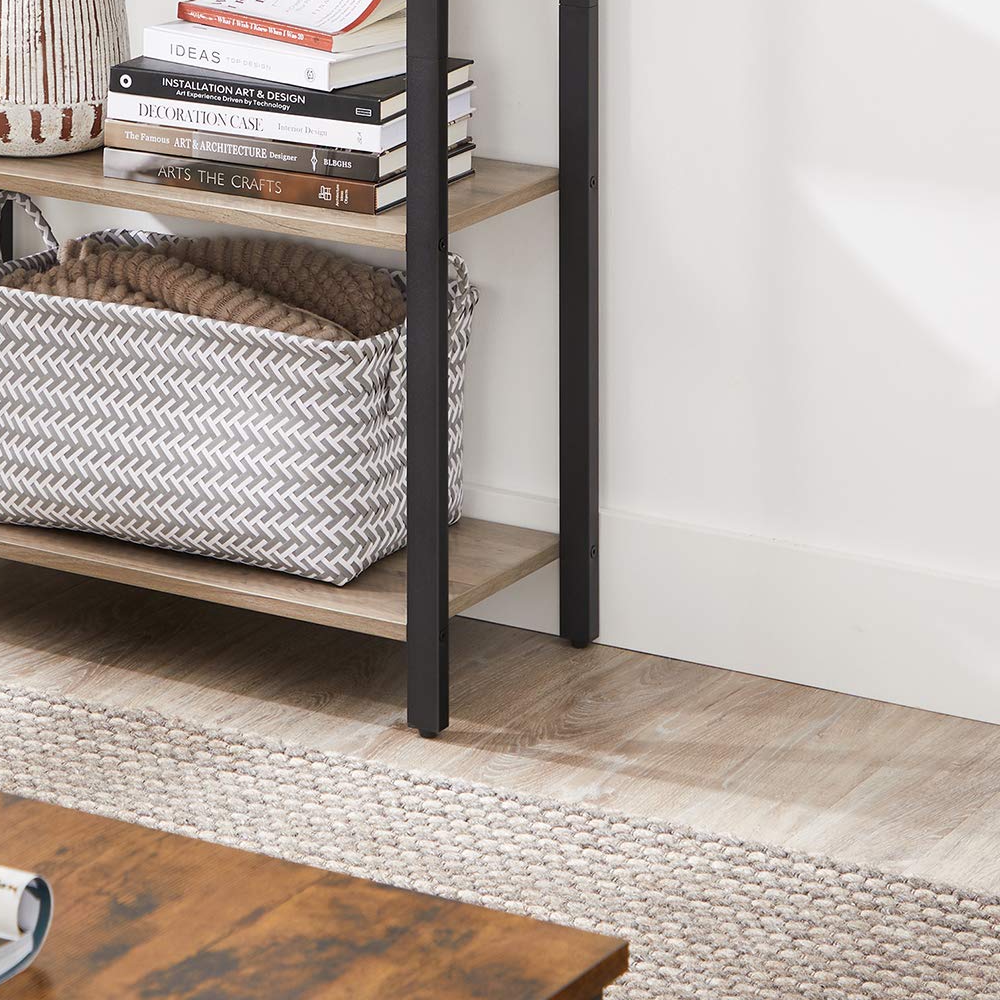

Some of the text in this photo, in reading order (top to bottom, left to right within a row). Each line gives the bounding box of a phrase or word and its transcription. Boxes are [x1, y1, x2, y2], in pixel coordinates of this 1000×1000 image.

[217, 16, 231, 26] What
[236, 19, 250, 29] Wish
[254, 24, 268, 33] Knew
[268, 27, 283, 36] When
[170, 44, 221, 64] IDEAS
[162, 78, 306, 104] INSTALLATION ART & DESIGN
[186, 91, 222, 102] Experience
[222, 96, 243, 104] Driven
[244, 98, 252, 106] by
[253, 99, 291, 111] Technology
[138, 103, 328, 136] DECORATION CASE Interior Design
[125, 131, 139, 140] The
[140, 132, 170, 144] Famous
[174, 138, 191, 149] ART
[192, 140, 199, 150] &
[200, 141, 268, 159] ARCHITECTURE
[270, 152, 297, 162] Designer
[158, 165, 282, 194] ARTS THE CRAFTS
